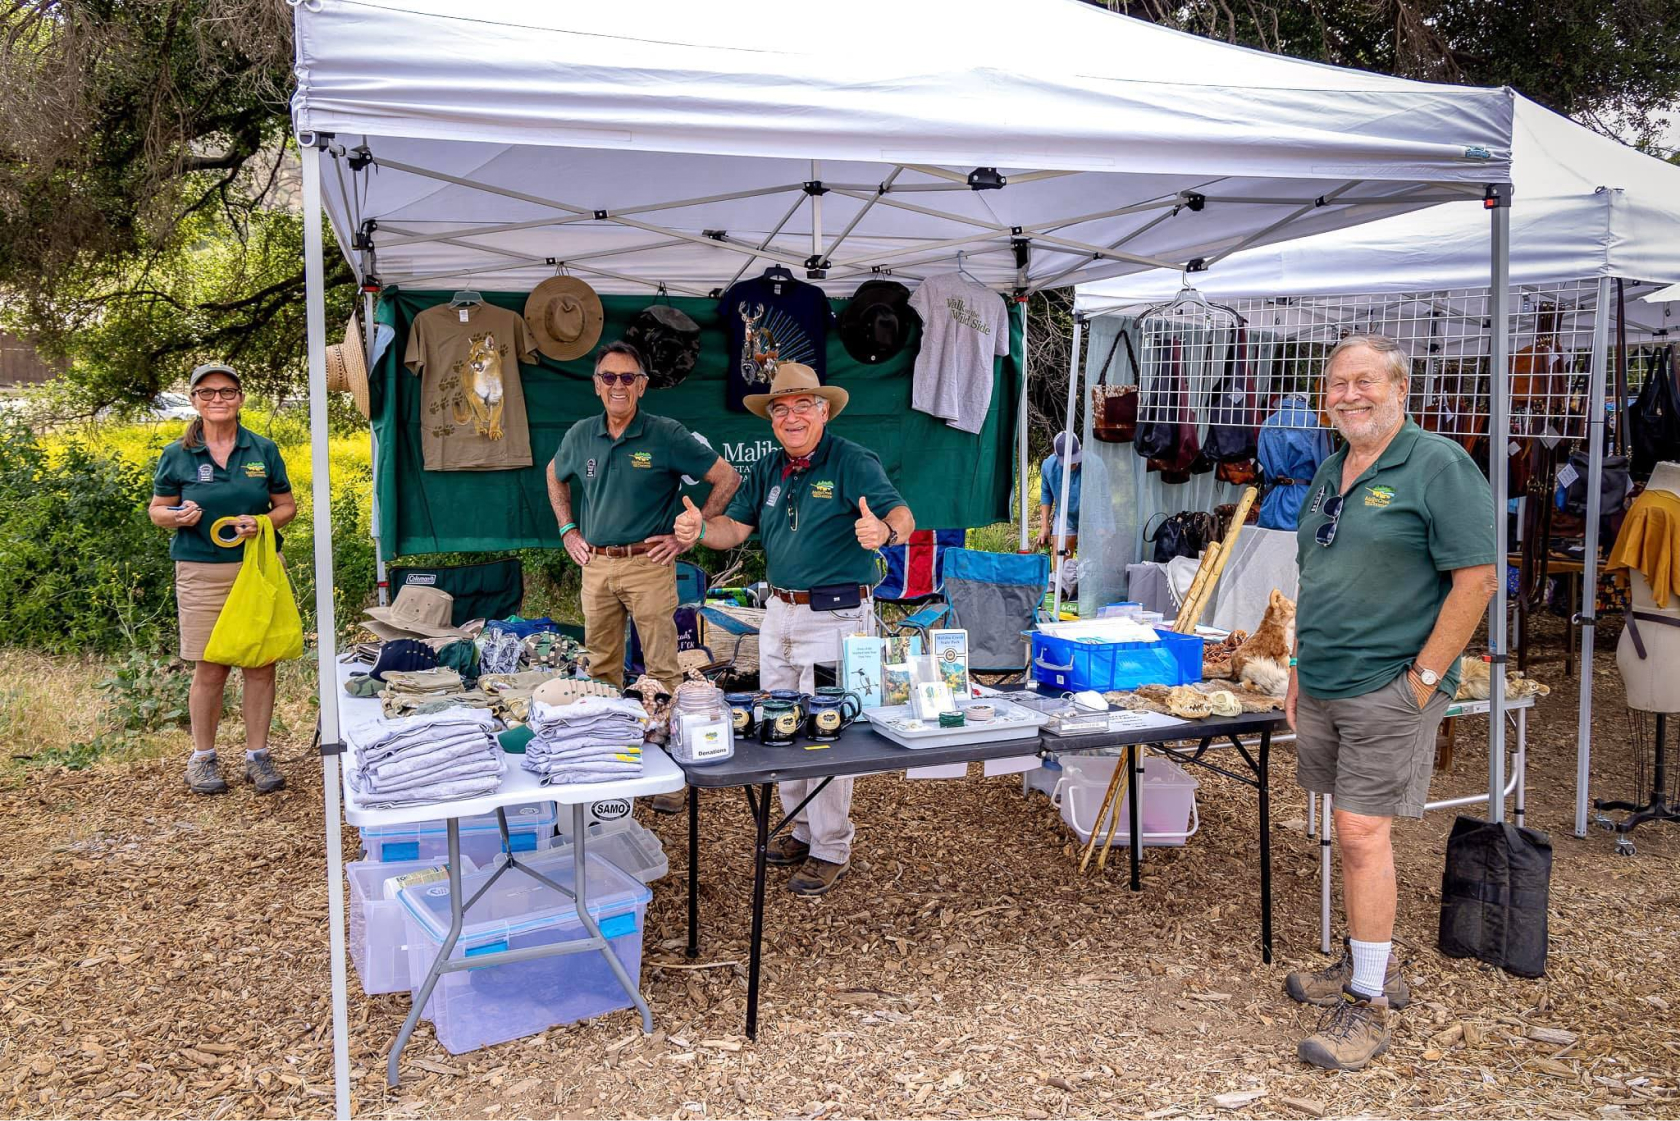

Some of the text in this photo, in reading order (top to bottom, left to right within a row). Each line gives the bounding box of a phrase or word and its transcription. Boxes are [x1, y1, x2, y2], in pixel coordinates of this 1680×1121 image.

[951, 309, 991, 335] Wild Side
[722, 440, 783, 463] Malib
[698, 748, 727, 757] Donations
[597, 803, 626, 814] SAMO
